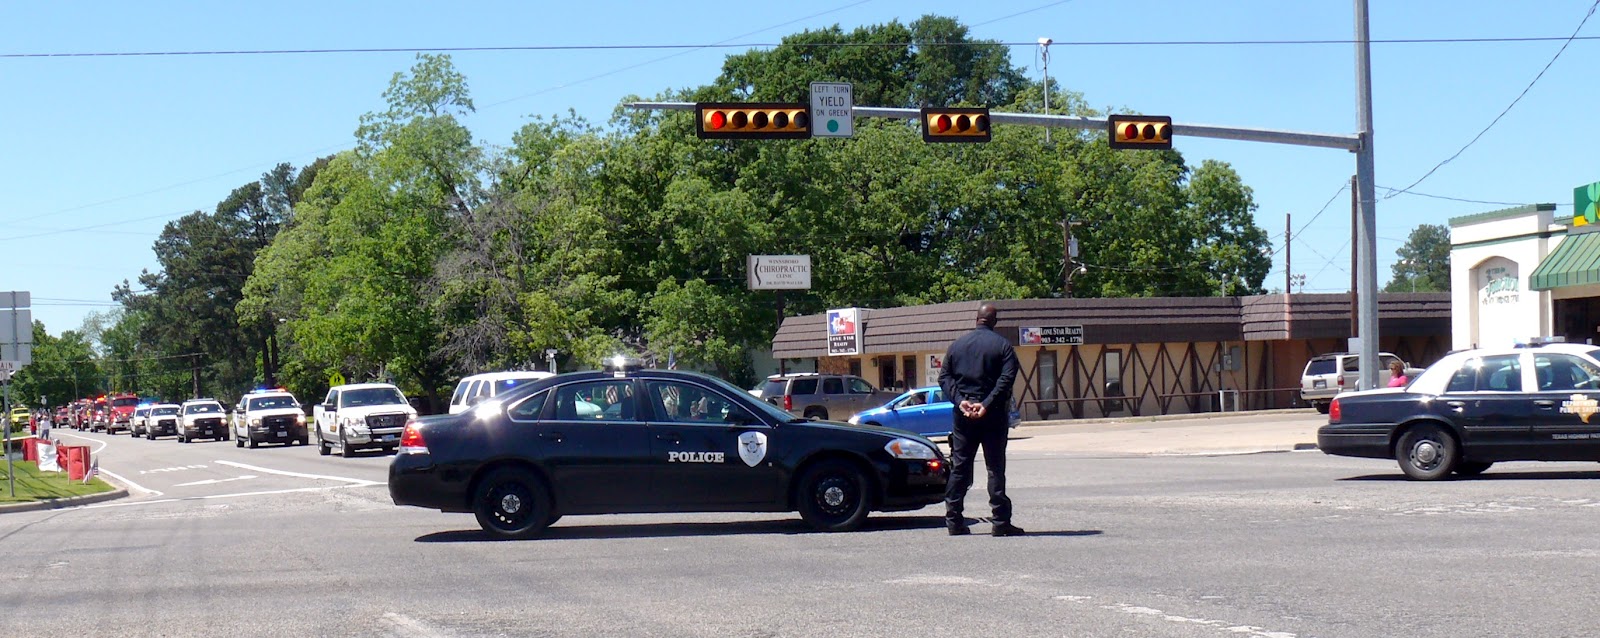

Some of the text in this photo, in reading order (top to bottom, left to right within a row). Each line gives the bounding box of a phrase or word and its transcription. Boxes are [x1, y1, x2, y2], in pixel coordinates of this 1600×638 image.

[833, 86, 849, 94] TURN
[819, 96, 845, 107] YIELD
[816, 109, 848, 117] ON GREEN
[759, 265, 809, 273] CHIROPRACTIC
[668, 451, 725, 463] POLICE
